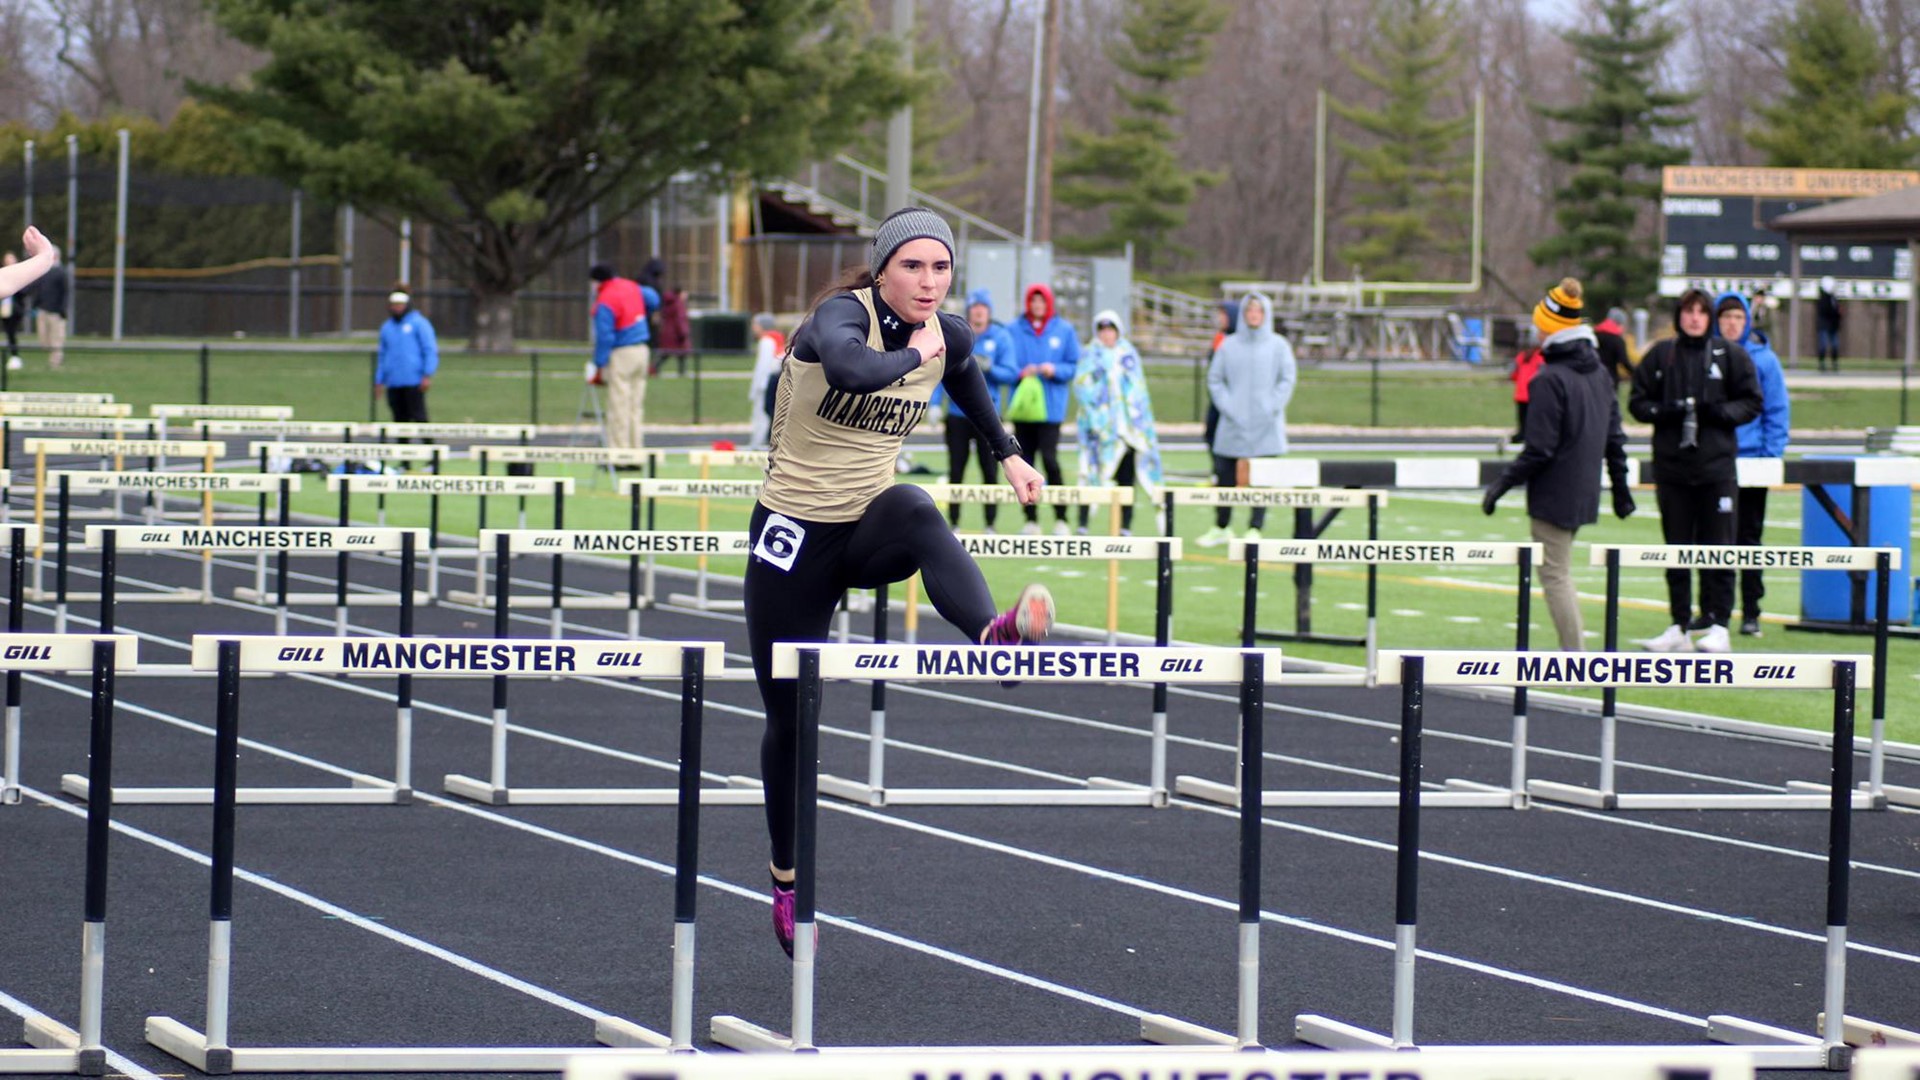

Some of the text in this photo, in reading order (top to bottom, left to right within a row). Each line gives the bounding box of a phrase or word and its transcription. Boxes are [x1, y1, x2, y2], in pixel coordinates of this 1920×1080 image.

[816, 386, 928, 437] MANCHEST
[71, 442, 181, 455] MANCHESTER
[306, 447, 392, 458] MANCHESTER
[525, 451, 610, 461] MANCHESTER
[118, 475, 229, 488] MANCHESTER
[397, 478, 505, 491] MANCHESTER
[687, 483, 761, 496] MANCHES
[951, 487, 1081, 502] MANCHTER
[1218, 492, 1321, 504] MANCHESTER
[141, 529, 376, 547] GILL MANCHESTER GILL
[534, 537, 562, 547] GILL
[573, 534, 719, 552] MANCHESTER
[763, 525, 798, 559] 6
[1105, 544, 1132, 553] GILL
[1280, 544, 1494, 562] GILL MANCHESTER GILL
[1640, 549, 1853, 566] GILL MANCHESTER GILL
[4, 645, 52, 661] GILL
[277, 642, 643, 672] GILL MANCHESTER GILL
[854, 650, 1204, 678] GILL MANCHESTER GILL
[1456, 656, 1796, 685] GILL MANCHESTER GILL
